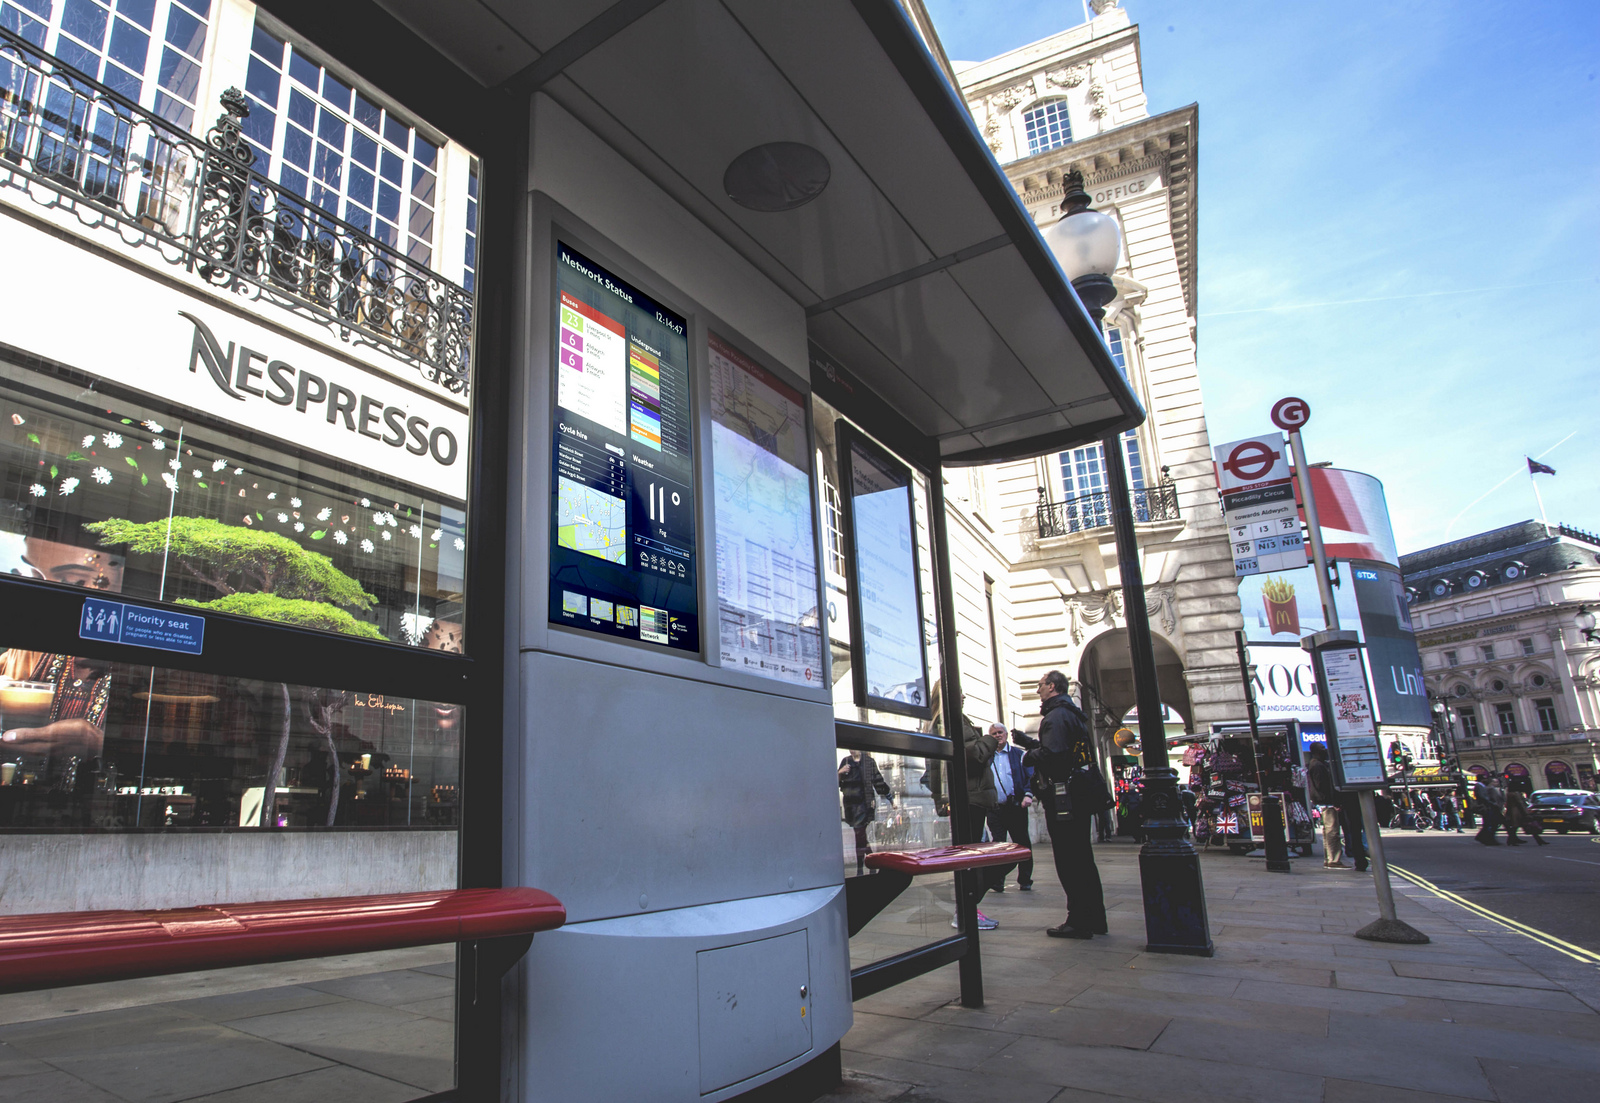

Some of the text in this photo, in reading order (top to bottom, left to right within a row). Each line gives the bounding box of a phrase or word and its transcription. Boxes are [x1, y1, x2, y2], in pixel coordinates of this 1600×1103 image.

[1095, 180, 1147, 203] OFFICE
[562, 251, 633, 304] Network Status
[562, 295, 578, 309] Buses
[567, 312, 578, 328] 23
[655, 311, 683, 335] 12:14:47
[569, 334, 576, 346] 6
[631, 334, 662, 357] Underground
[569, 354, 576, 366] 6
[178, 310, 458, 466] NESPRESSO
[1278, 401, 1305, 425] G
[560, 422, 587, 440] Cycle hire
[632, 454, 654, 469] Weather
[1232, 494, 1262, 504] Piccadilly
[1234, 506, 1288, 520] towards Aldwych
[1258, 542, 1276, 550] N13
[1282, 538, 1300, 546] N18
[1236, 545, 1250, 554] 139
[1236, 562, 1258, 571] N113
[1362, 571, 1377, 580] TDK
[128, 612, 189, 630] Priority seat
[641, 631, 659, 640] Network
